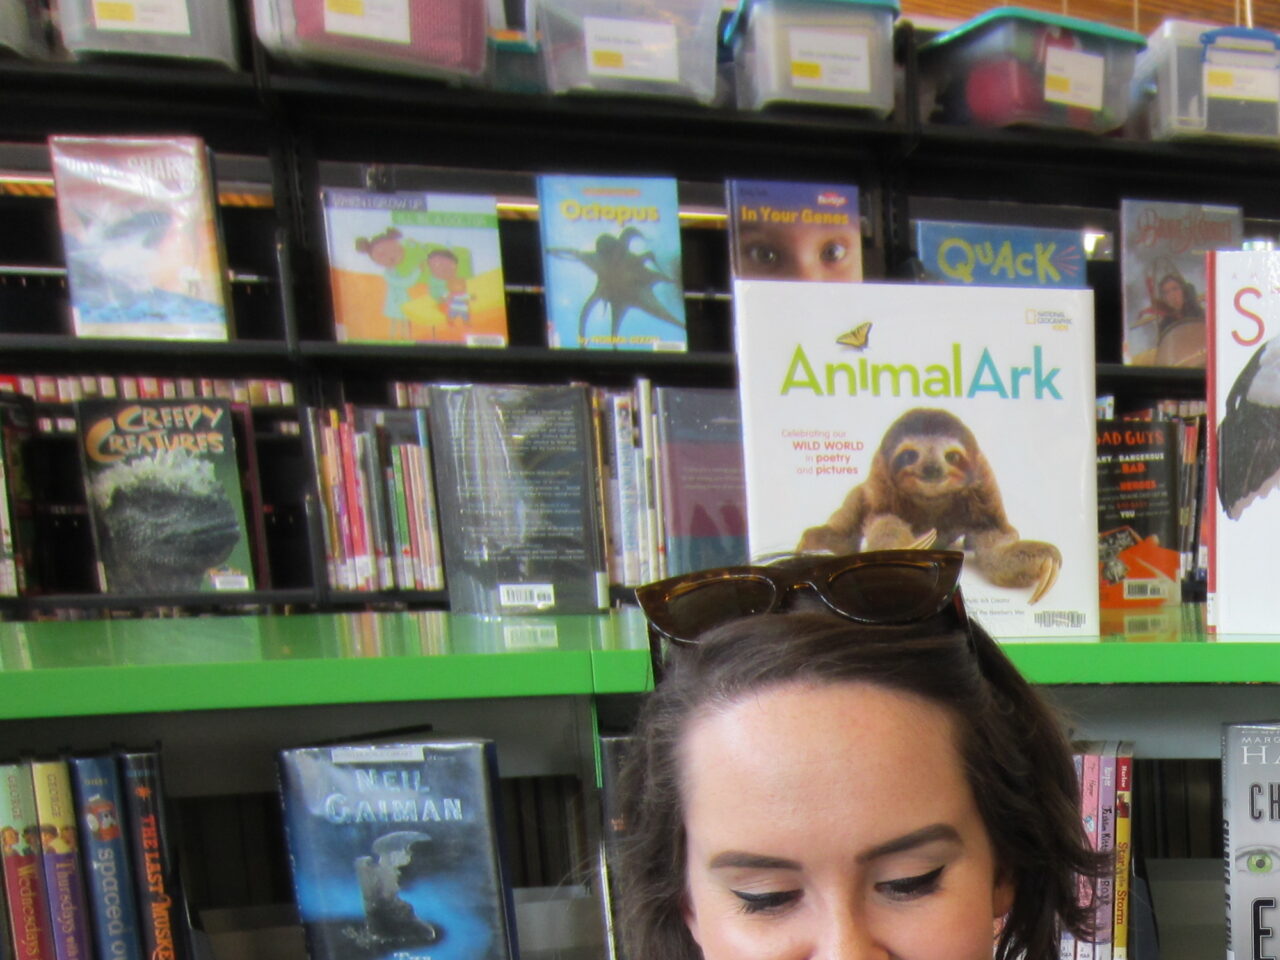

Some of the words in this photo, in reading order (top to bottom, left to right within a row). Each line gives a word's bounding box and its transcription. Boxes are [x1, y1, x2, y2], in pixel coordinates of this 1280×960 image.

[560, 199, 659, 226] Octopus
[742, 206, 757, 221] In
[761, 206, 798, 223] Your
[802, 208, 849, 225] Genes
[780, 343, 963, 397] Animal
[967, 345, 1064, 400] Ark
[117, 404, 223, 432] CREEPY
[86, 418, 224, 463] CREATURES
[781, 428, 830, 439] Celebrating
[793, 441, 820, 451] WILD
[824, 441, 864, 451] WORLD
[1125, 431, 1165, 445] GUYS
[816, 453, 851, 465] poetry
[816, 464, 858, 475] pictures
[1122, 463, 1145, 474] BAD
[355, 768, 430, 793] NEIL
[324, 793, 463, 823] GAIMAN
[140, 813, 159, 850] THE
[1118, 840, 1128, 867] Star
[143, 852, 165, 893] LAST
[55, 860, 76, 934] Thursdays
[95, 847, 129, 937] spaced
[17, 862, 42, 956] Wednesdays
[1115, 889, 1128, 925] Storm
